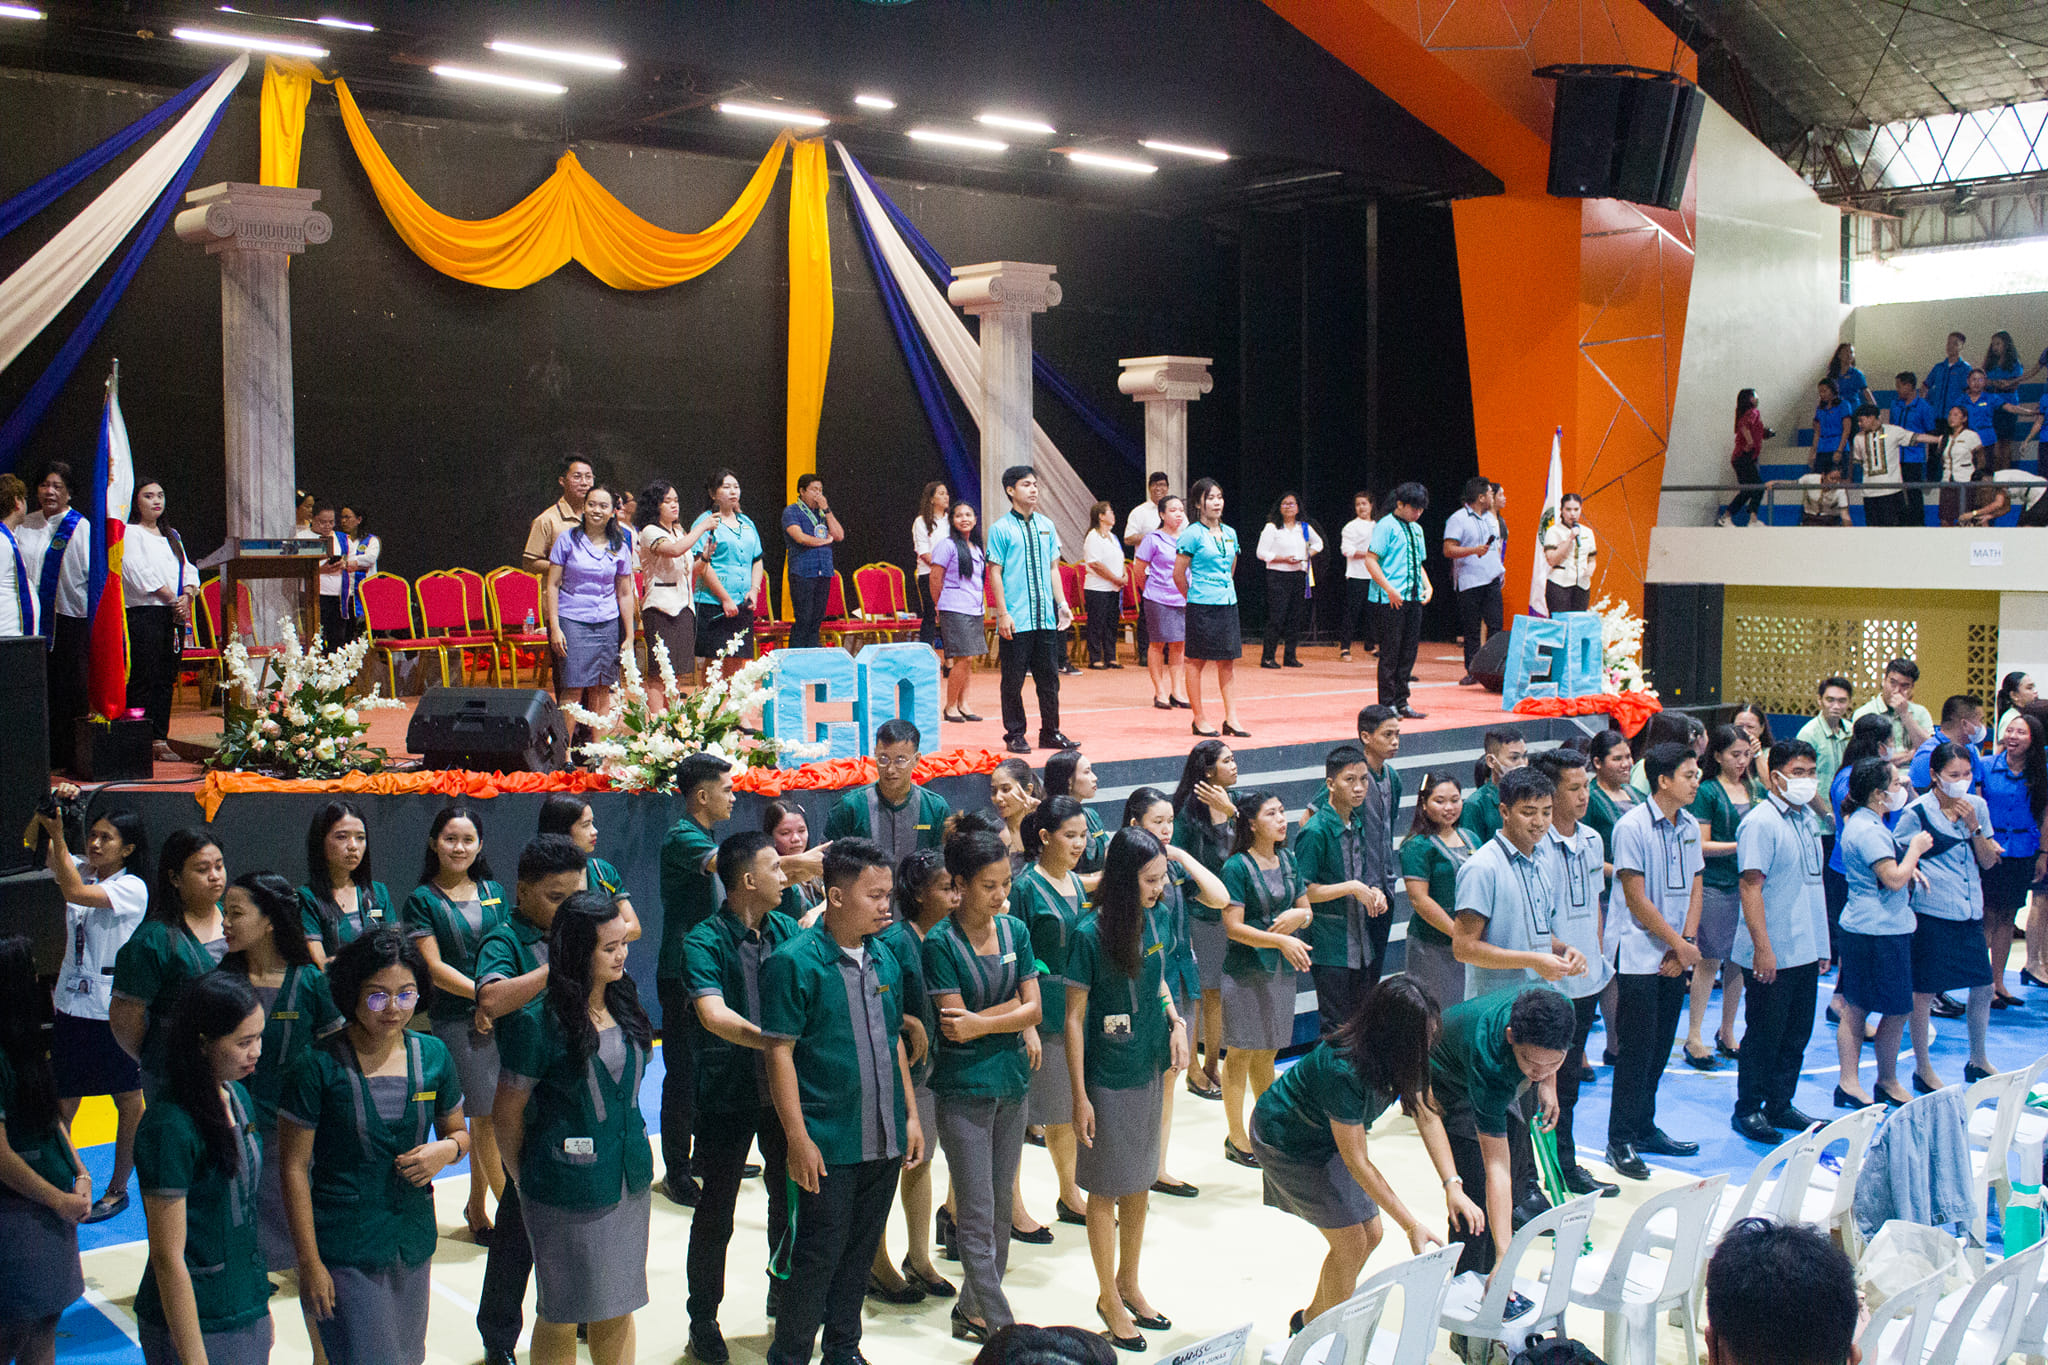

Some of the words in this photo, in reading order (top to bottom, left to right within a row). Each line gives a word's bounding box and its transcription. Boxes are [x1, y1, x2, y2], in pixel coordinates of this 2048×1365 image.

[1972, 549, 2001, 558] MATH
[764, 642, 941, 773] CO
[1502, 611, 1602, 711] ED
